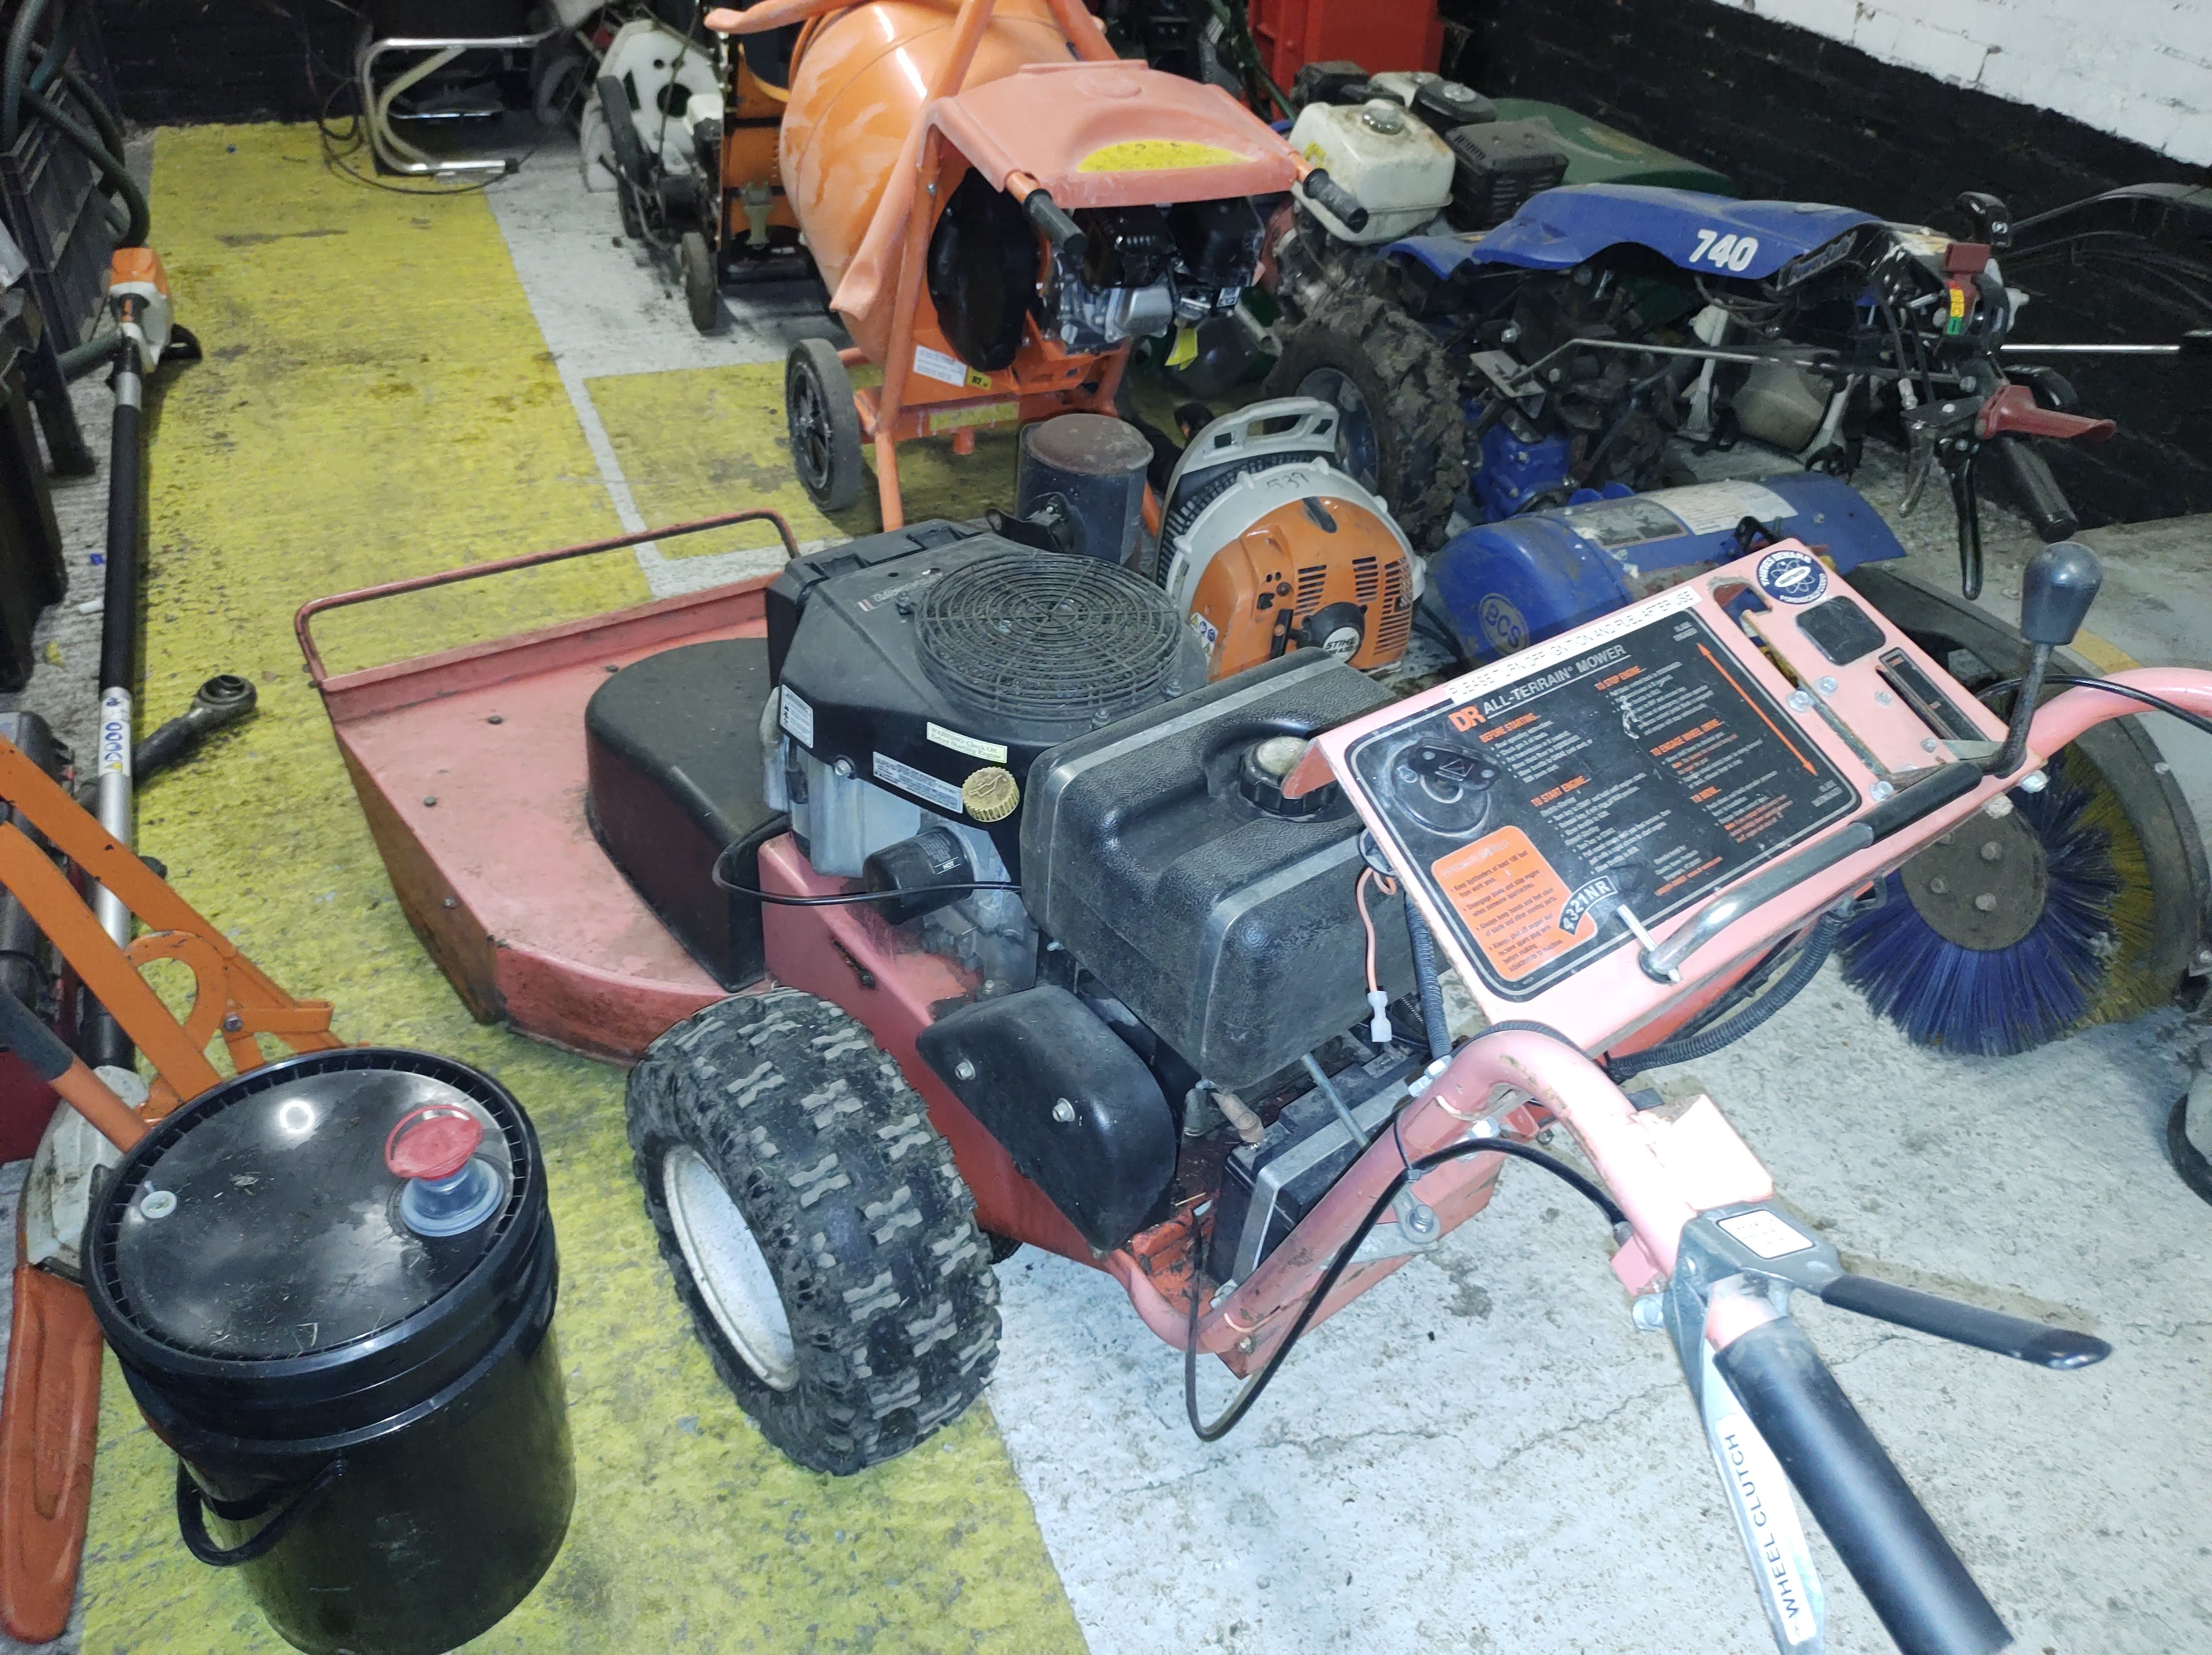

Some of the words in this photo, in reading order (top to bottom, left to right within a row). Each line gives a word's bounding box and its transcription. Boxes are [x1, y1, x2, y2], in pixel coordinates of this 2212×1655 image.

[1689, 229, 1758, 272] 740
[1450, 674, 1494, 694] PLEASE
[1526, 652, 1545, 666] OFF
[1594, 624, 1615, 637] AND
[1614, 615, 1642, 626] FUEL
[1642, 600, 1670, 617] AFTER
[1674, 591, 1693, 605] USE
[1448, 706, 1485, 732] DR
[1576, 644, 1627, 673] MOWER
[1563, 881, 1611, 929] 4321NR
[1724, 1433, 1767, 1526] CLUTCH
[1764, 1533, 1799, 1619] WHEEL
